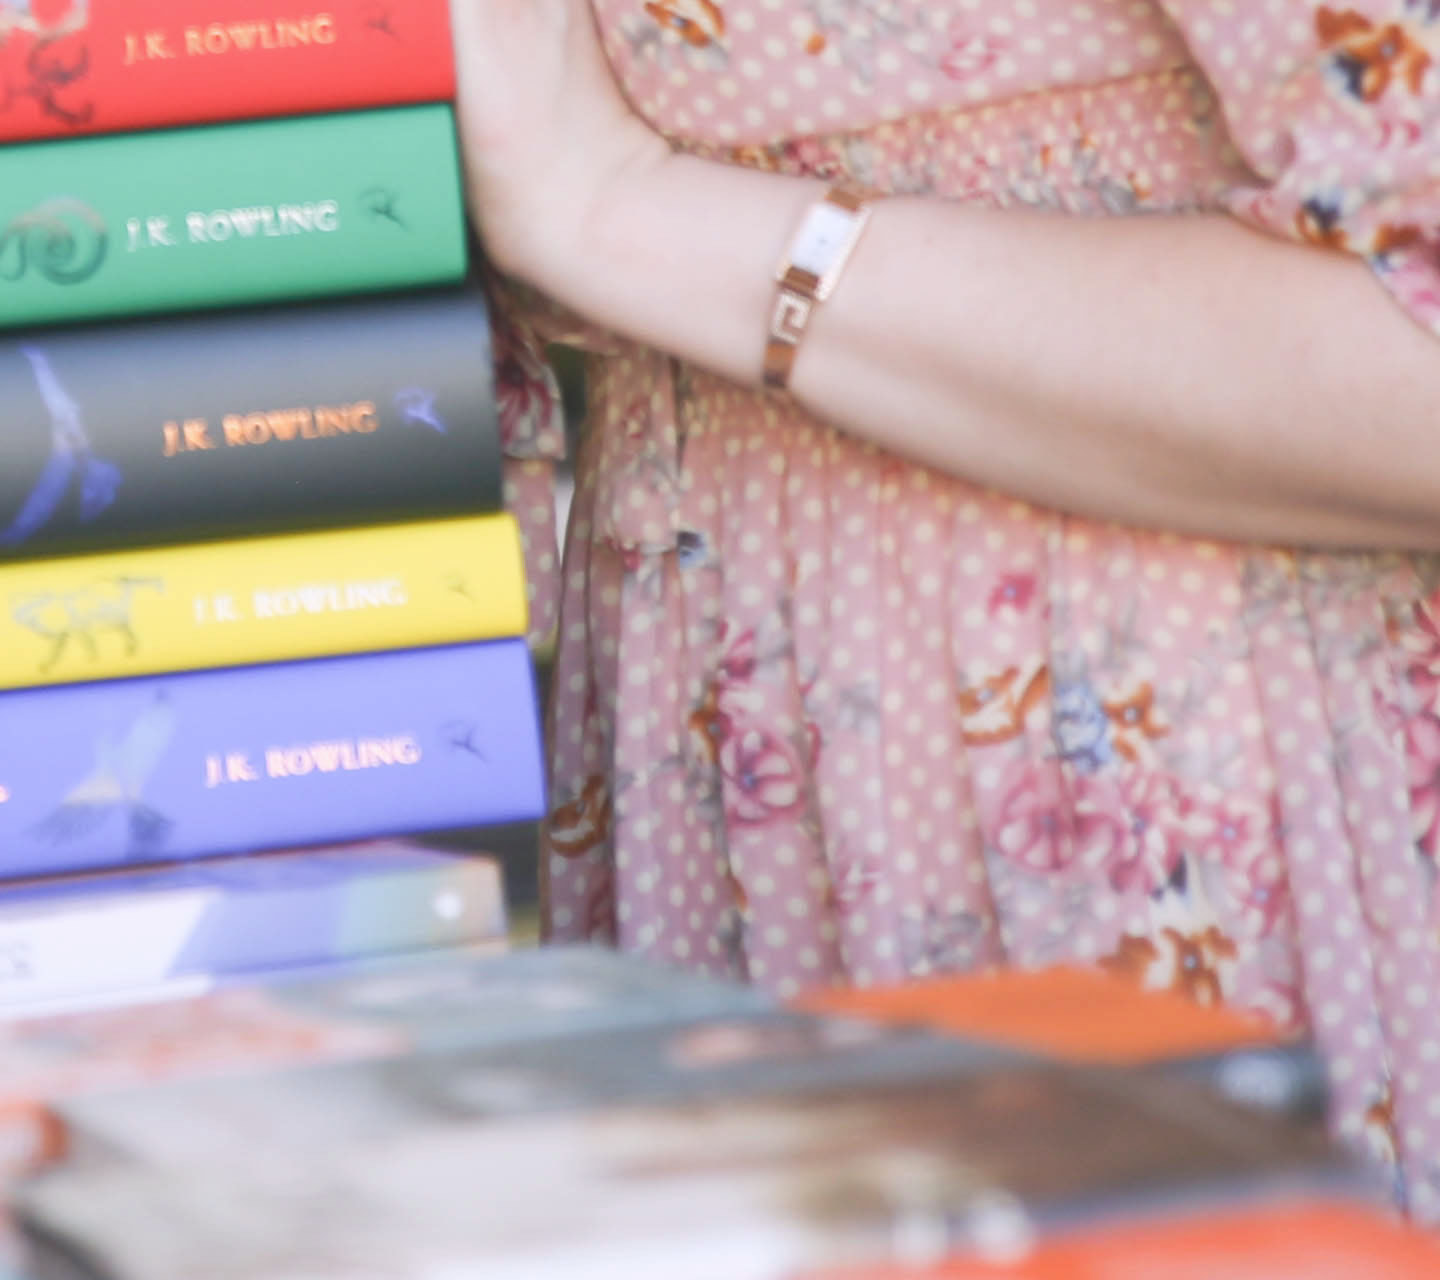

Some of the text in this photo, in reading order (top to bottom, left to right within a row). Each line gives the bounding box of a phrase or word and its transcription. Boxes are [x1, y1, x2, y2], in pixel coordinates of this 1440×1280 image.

[184, 12, 336, 56] ROWLING
[185, 200, 339, 243] ROWLING
[222, 400, 379, 446] ROWLING
[252, 578, 407, 619] ROWLING
[266, 736, 421, 777] ROWLING
